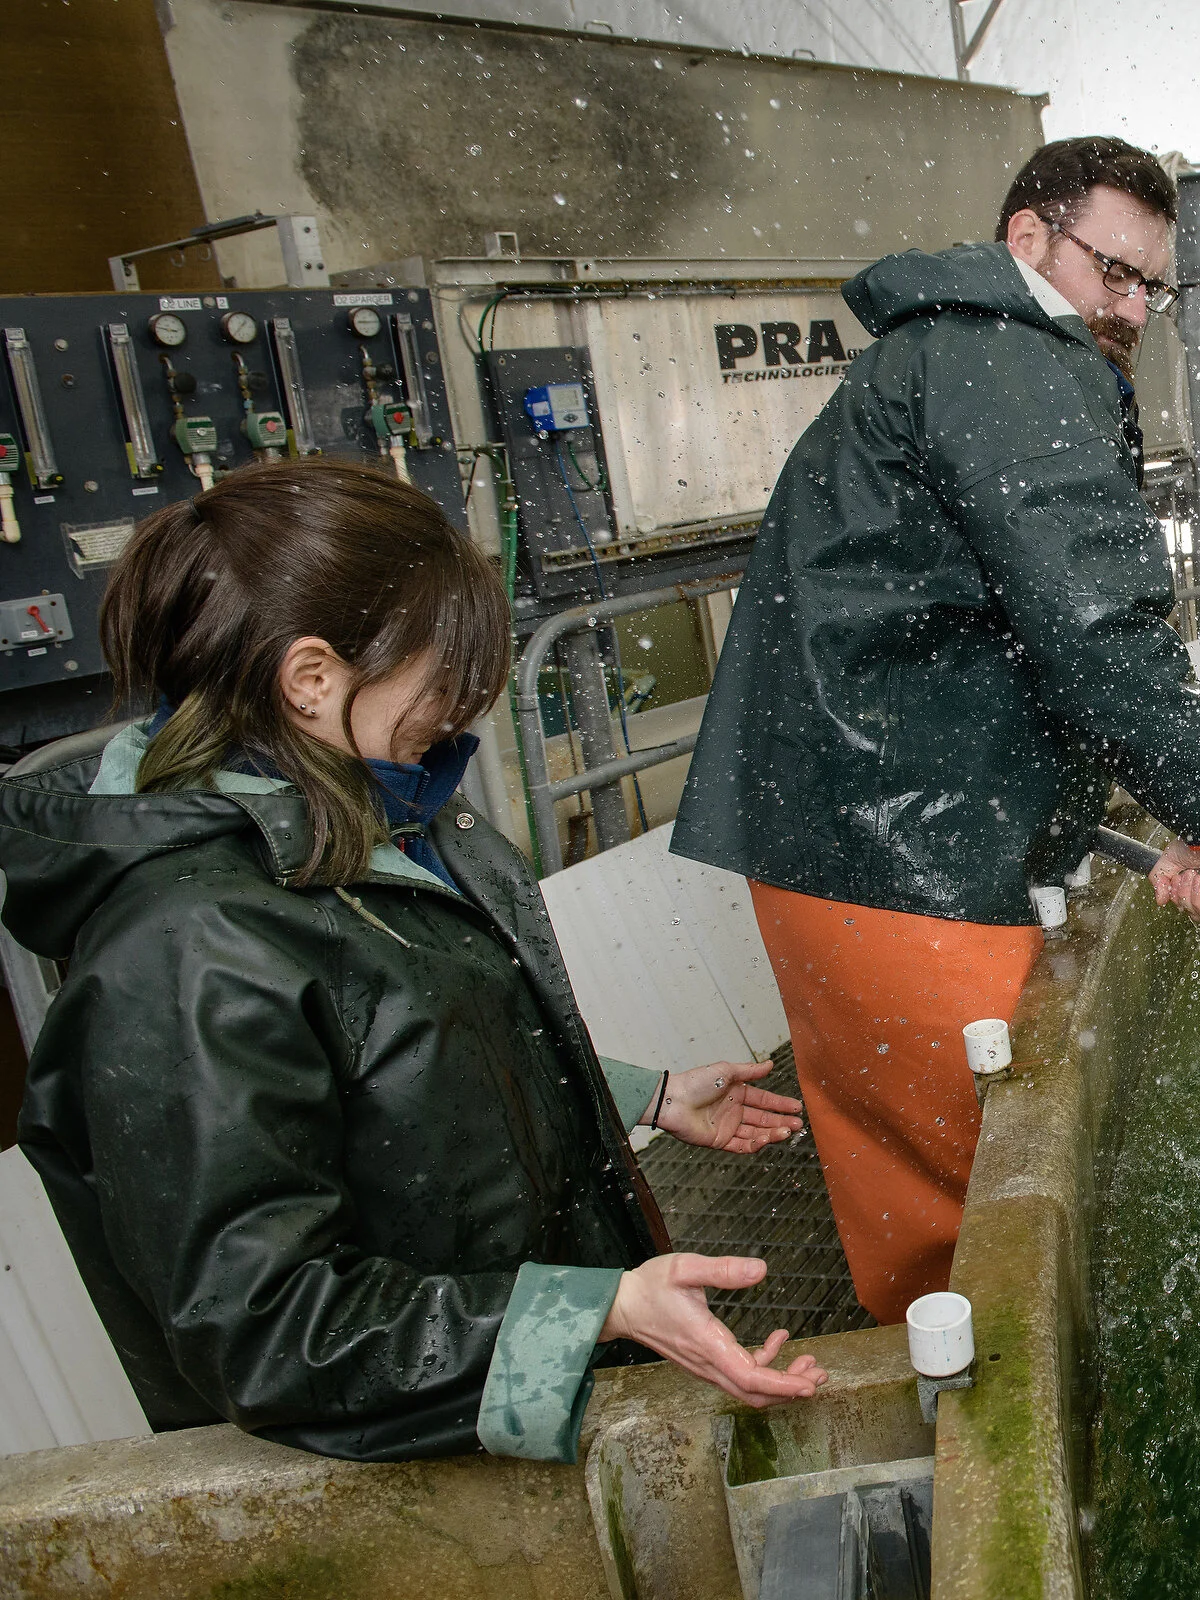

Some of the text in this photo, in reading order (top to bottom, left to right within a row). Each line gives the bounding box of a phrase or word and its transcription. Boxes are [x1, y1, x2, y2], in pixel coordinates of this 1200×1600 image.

[178, 299, 200, 309] LINE
[219, 299, 226, 308] 2
[349, 294, 391, 304] SPARGER
